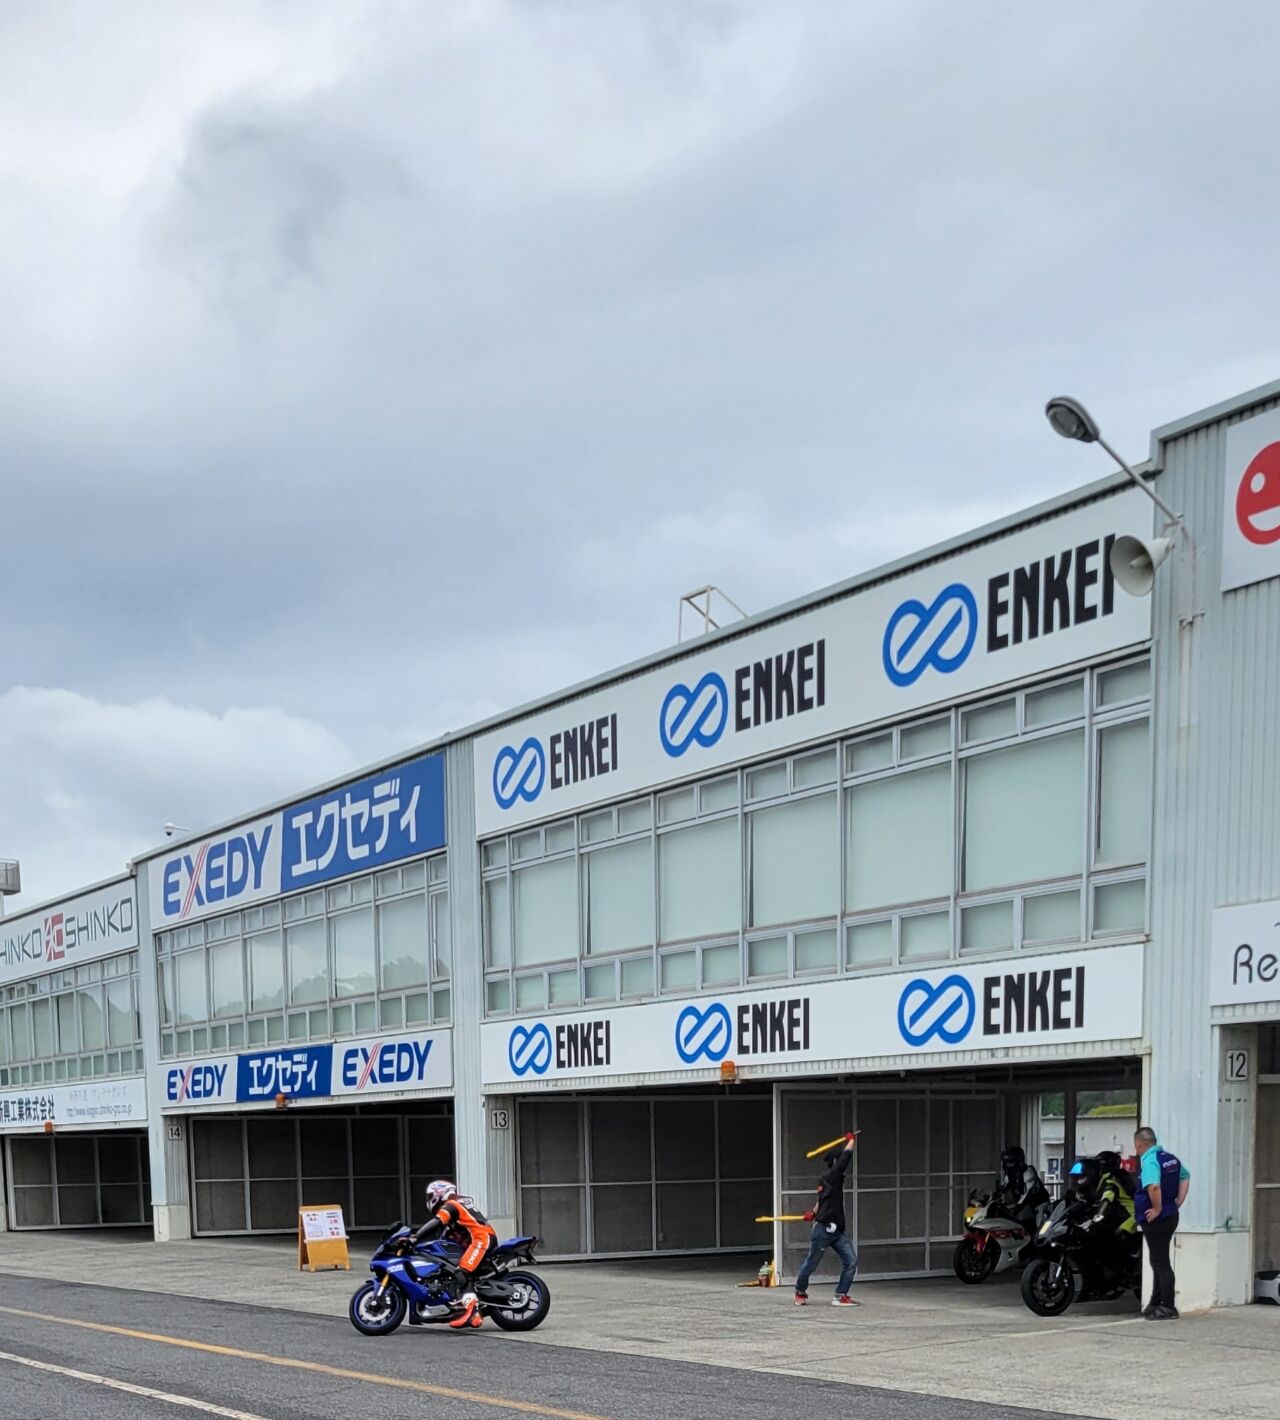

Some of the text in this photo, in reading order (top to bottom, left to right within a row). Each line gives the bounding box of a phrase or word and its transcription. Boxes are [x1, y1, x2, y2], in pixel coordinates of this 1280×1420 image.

[550, 533, 1116, 790] ENKEI ENKEI ENKEI
[291, 777, 420, 877] エクセディ
[163, 823, 274, 919] EXEDY
[65, 897, 133, 949] SHINKO
[1232, 943, 1279, 985] Re
[555, 966, 1085, 1069] ENKEI ENKEI ENKEI
[167, 1063, 228, 1103] EXEDY
[249, 1053, 318, 1095] エクセディ
[342, 1040, 433, 1090] EXEDY
[1227, 1052, 1246, 1078] 12
[169, 1127, 181, 1138] 14
[492, 1111, 507, 1127] 13
